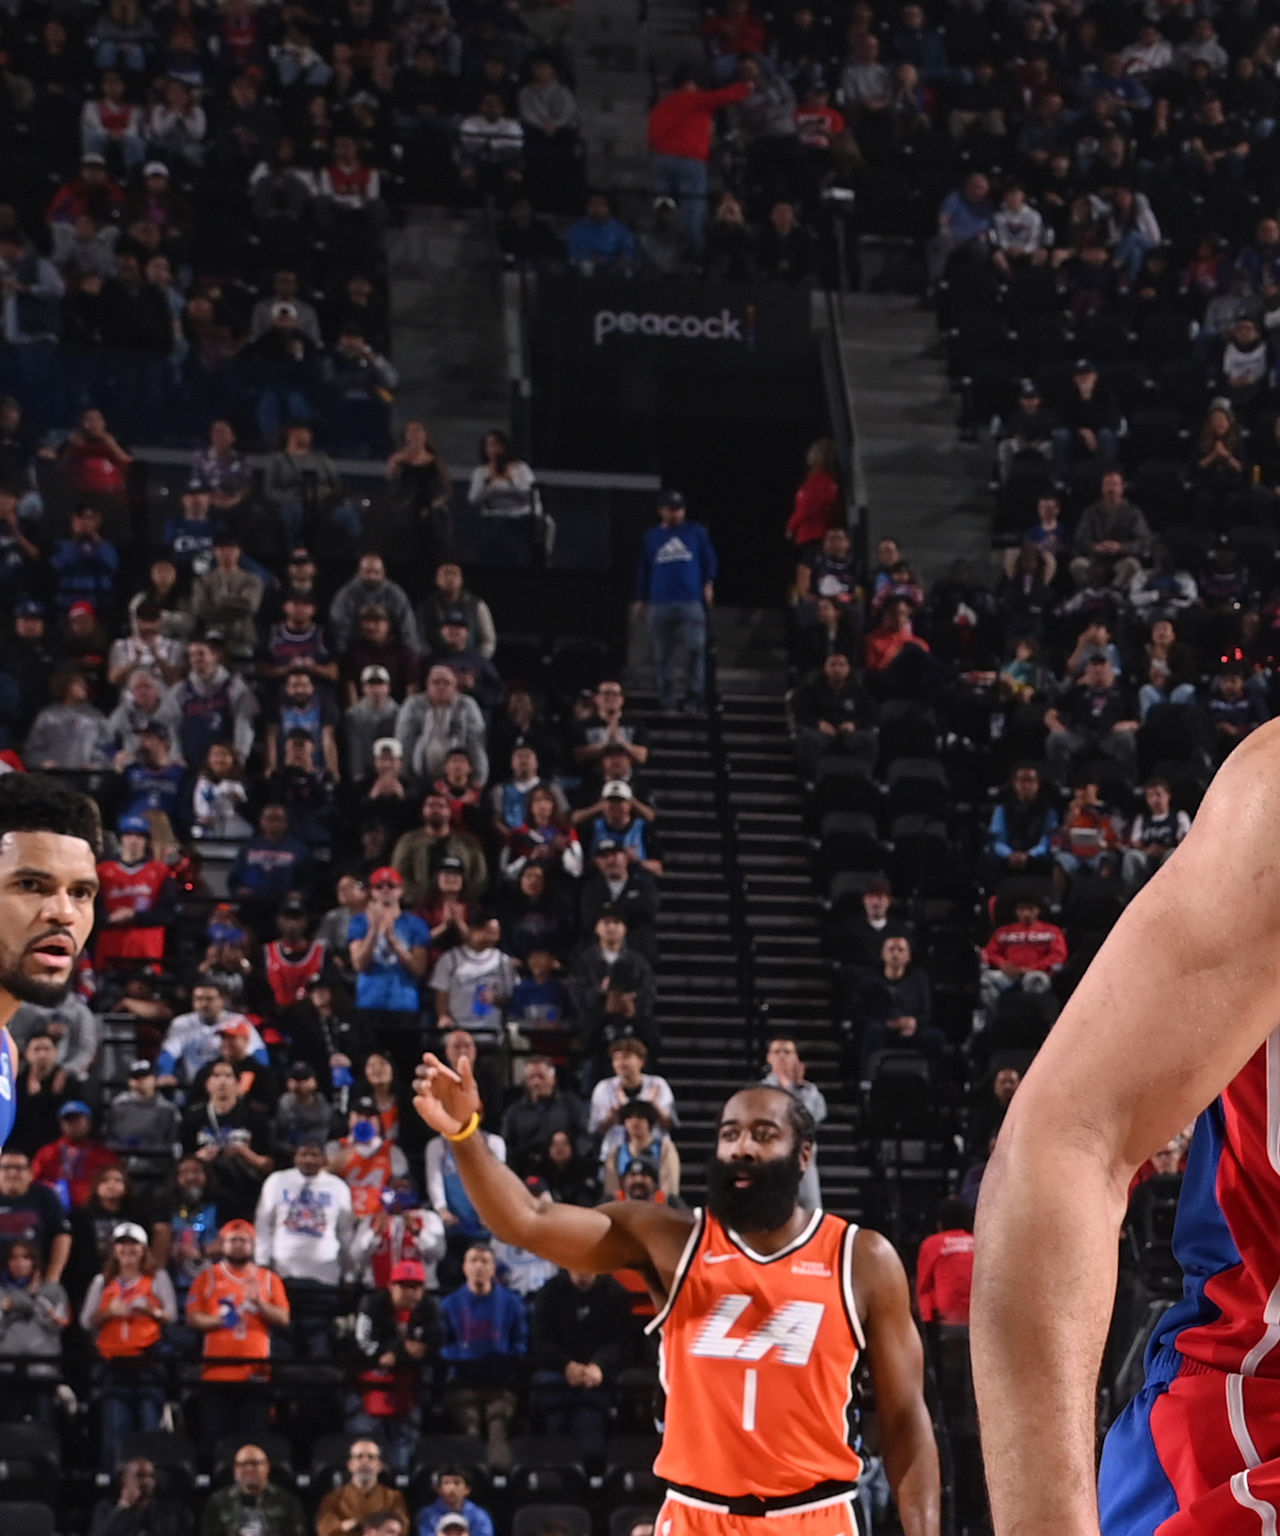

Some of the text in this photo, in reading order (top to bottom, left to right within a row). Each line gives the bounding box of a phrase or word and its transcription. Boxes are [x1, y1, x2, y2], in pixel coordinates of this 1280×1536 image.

[593, 307, 744, 346] peacock
[688, 1294, 826, 1367] LA
[742, 1368, 758, 1432] 1
